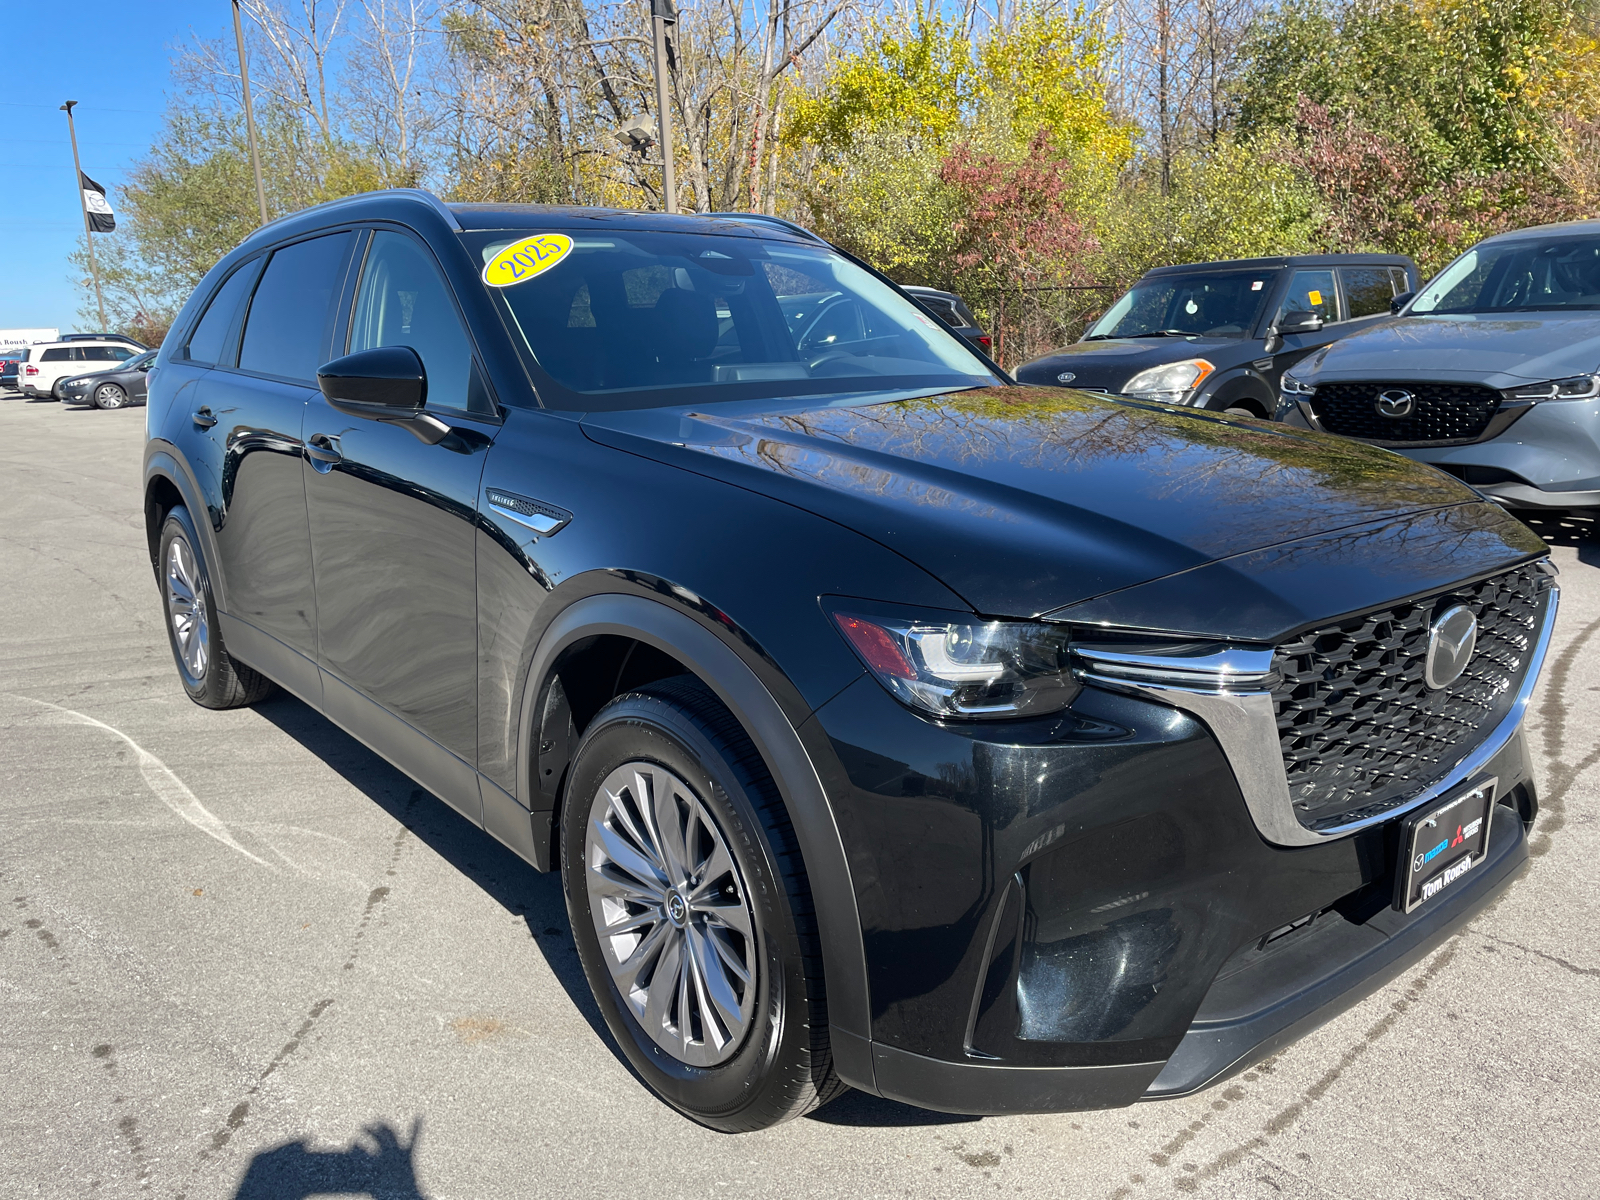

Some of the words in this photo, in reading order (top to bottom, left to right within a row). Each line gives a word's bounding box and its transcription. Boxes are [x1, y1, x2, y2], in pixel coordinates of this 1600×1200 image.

[499, 238, 562, 279] 2025
[1422, 877, 1442, 900] Tom
[1443, 855, 1472, 885] Roush
